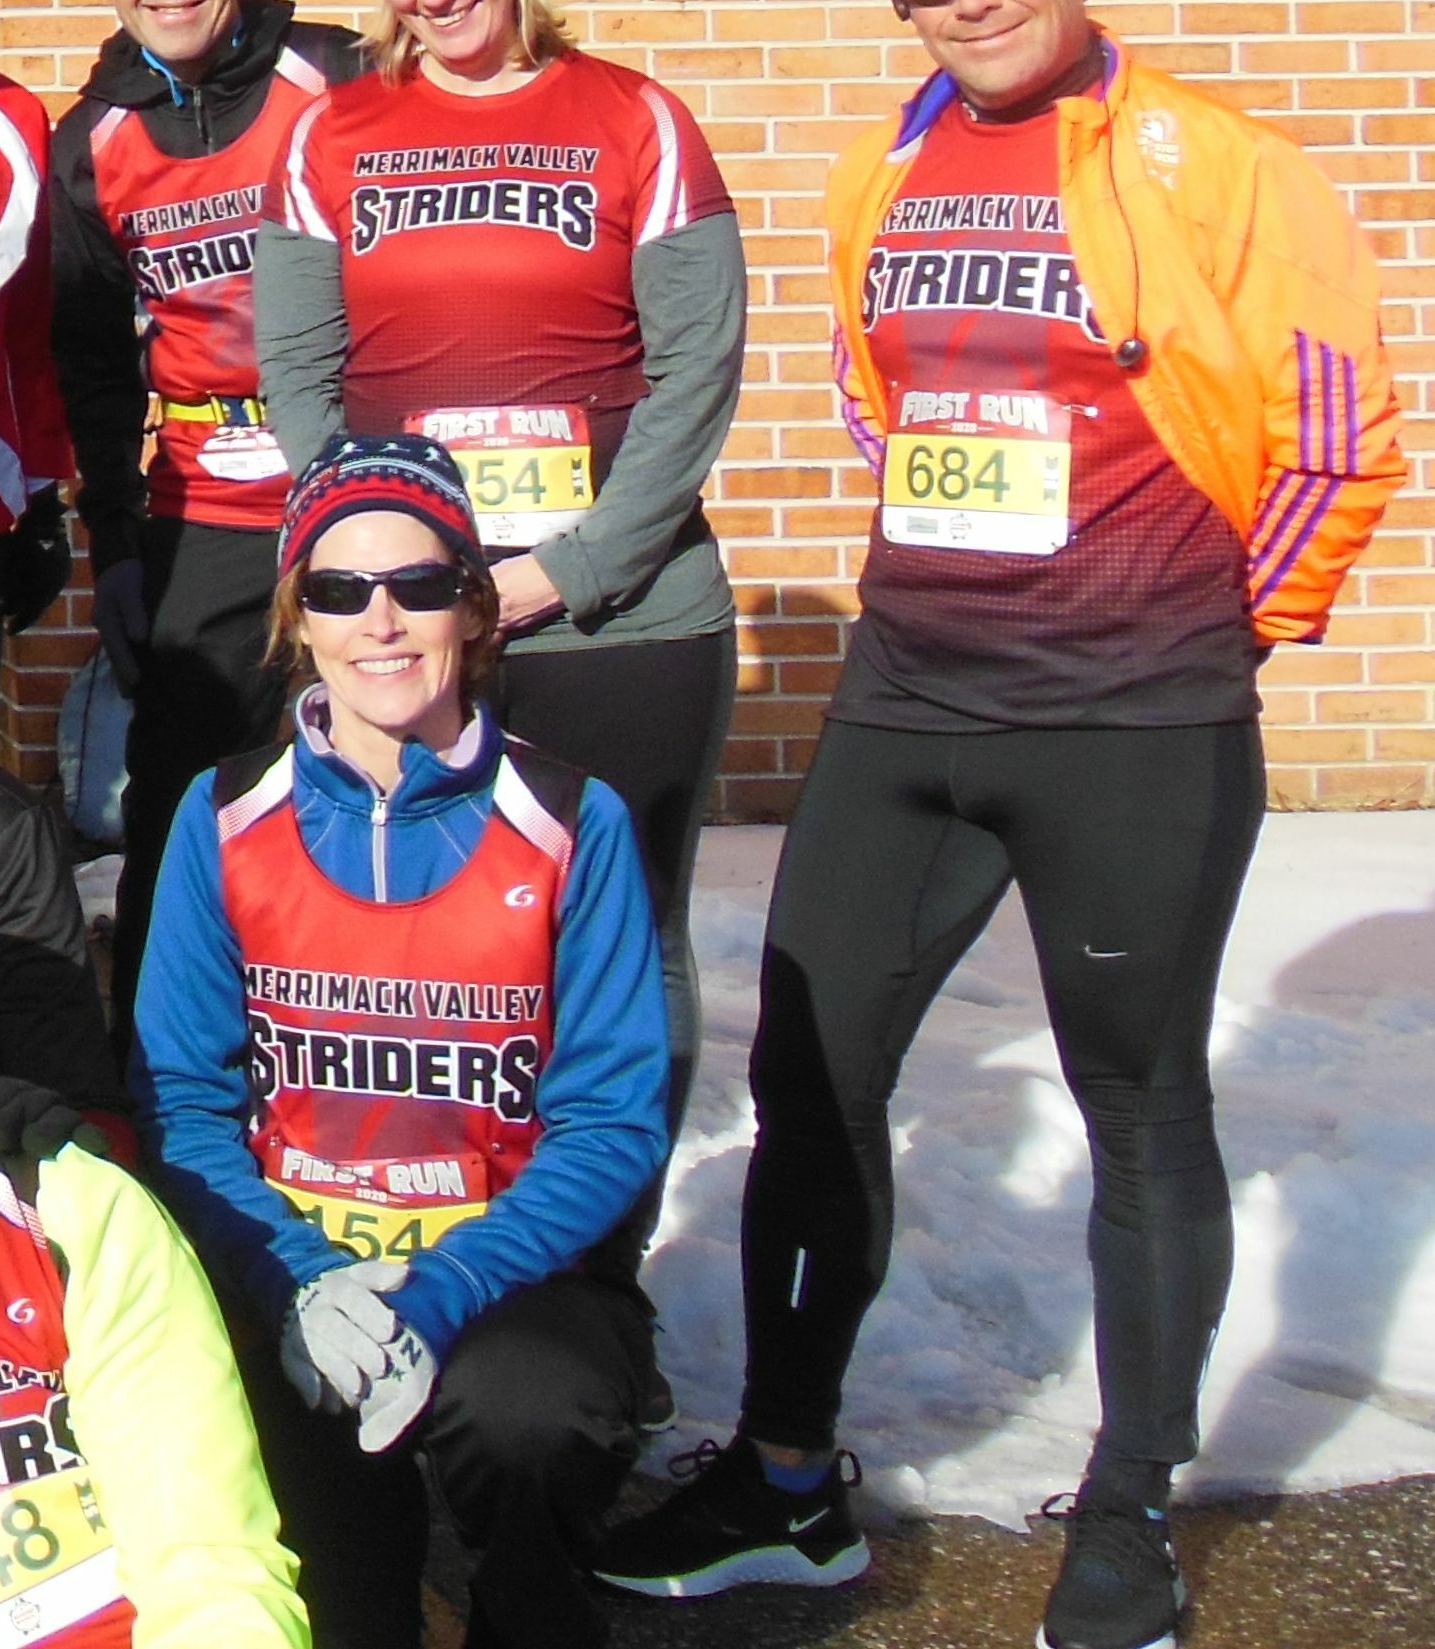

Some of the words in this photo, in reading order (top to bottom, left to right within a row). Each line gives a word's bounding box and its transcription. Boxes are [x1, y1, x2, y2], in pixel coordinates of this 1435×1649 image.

[353, 146, 499, 176] MERRIMACK
[505, 144, 600, 173] VALLEY
[122, 193, 242, 238] MERRIMACK
[350, 179, 600, 256] STRIDERS
[130, 234, 258, 305] STRID
[422, 410, 500, 442] FIRST
[509, 409, 574, 442] RUN
[900, 390, 971, 427] FIRST
[980, 393, 1049, 435] RUN
[906, 444, 1011, 503] 684
[242, 964, 416, 1017] MERRIMACK
[420, 980, 544, 1024] VALLEY
[247, 1008, 539, 1125] STRIDERS
[280, 1147, 374, 1185] FIRST
[387, 1159, 467, 1199] RUN
[354, 1188, 388, 1204] 2020
[302, 1204, 424, 1263] 154
